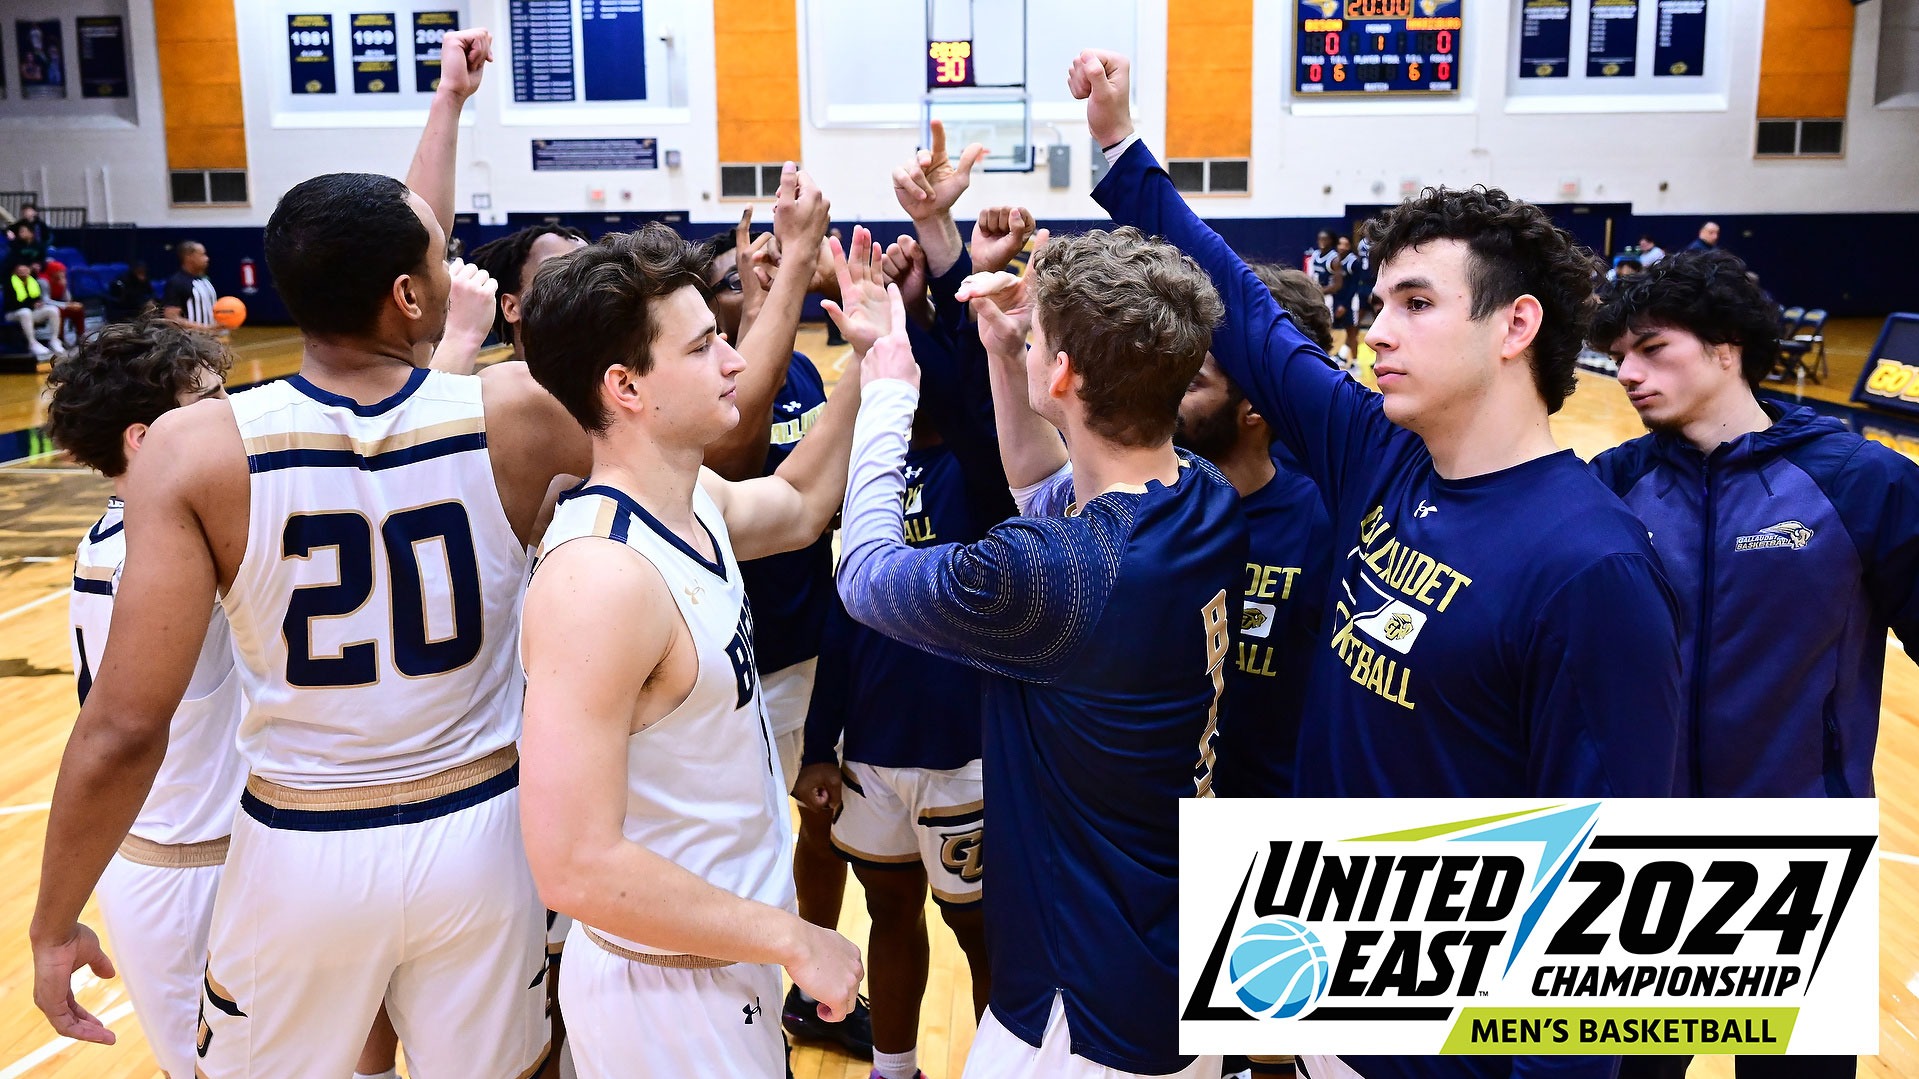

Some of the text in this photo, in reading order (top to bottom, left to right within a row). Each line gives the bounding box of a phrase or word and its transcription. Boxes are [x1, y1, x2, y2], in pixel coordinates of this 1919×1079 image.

[1325, 32, 1340, 55] 0
[1436, 31, 1452, 54] 0
[936, 58, 966, 82] 30
[1309, 64, 1322, 82] 0
[1437, 62, 1450, 80] 0
[280, 498, 485, 690] 20
